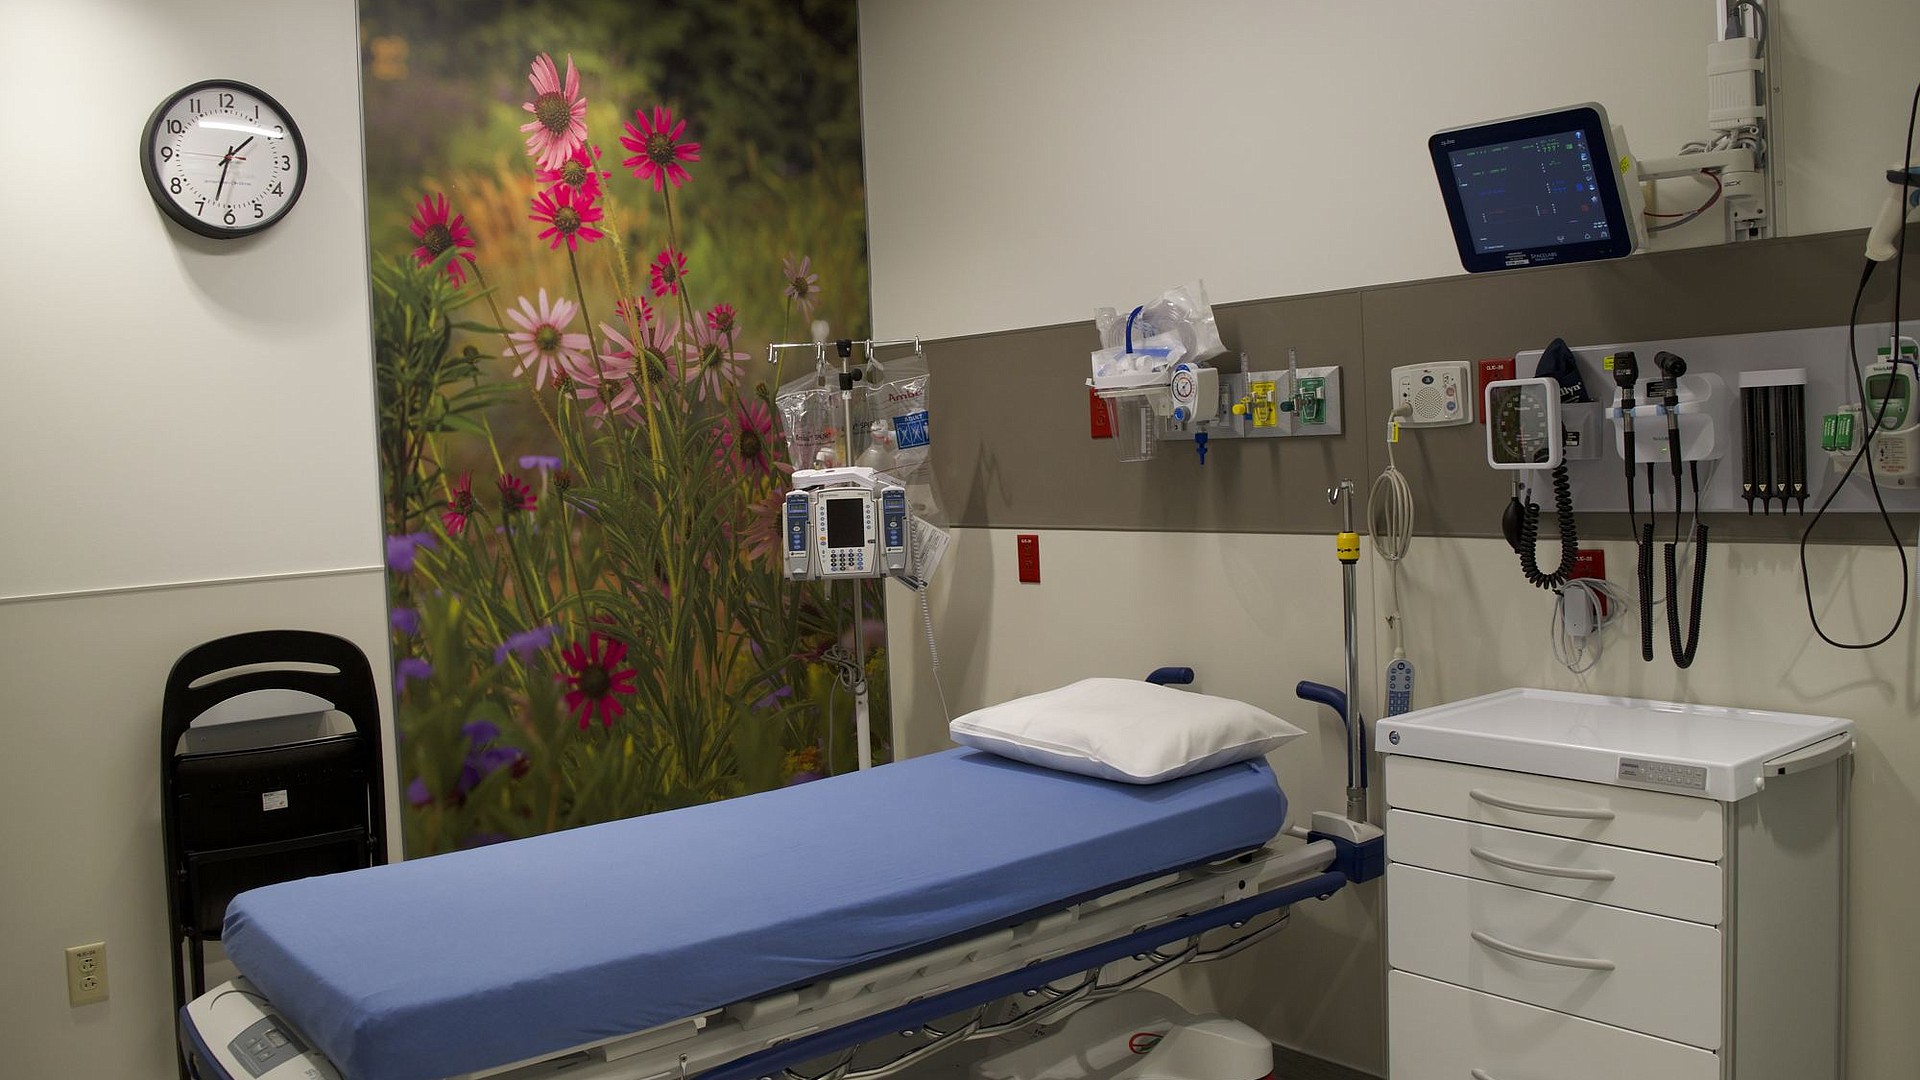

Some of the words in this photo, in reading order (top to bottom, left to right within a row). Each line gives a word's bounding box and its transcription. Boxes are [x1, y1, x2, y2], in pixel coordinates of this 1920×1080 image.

[189, 98, 201, 114] 11
[219, 93, 234, 109] 12
[254, 105, 259, 119] 1
[166, 119, 182, 134] 10
[274, 125, 284, 140] 2
[160, 146, 173, 162] 9
[281, 155, 291, 171] 3
[170, 177, 182, 194] 8
[271, 182, 284, 197] 4
[195, 201, 205, 216] 7
[253, 203, 264, 219] 5
[223, 209, 236, 225] 6
[1560, 384, 1581, 396] llyn
[904, 413, 923, 422] ADULT
